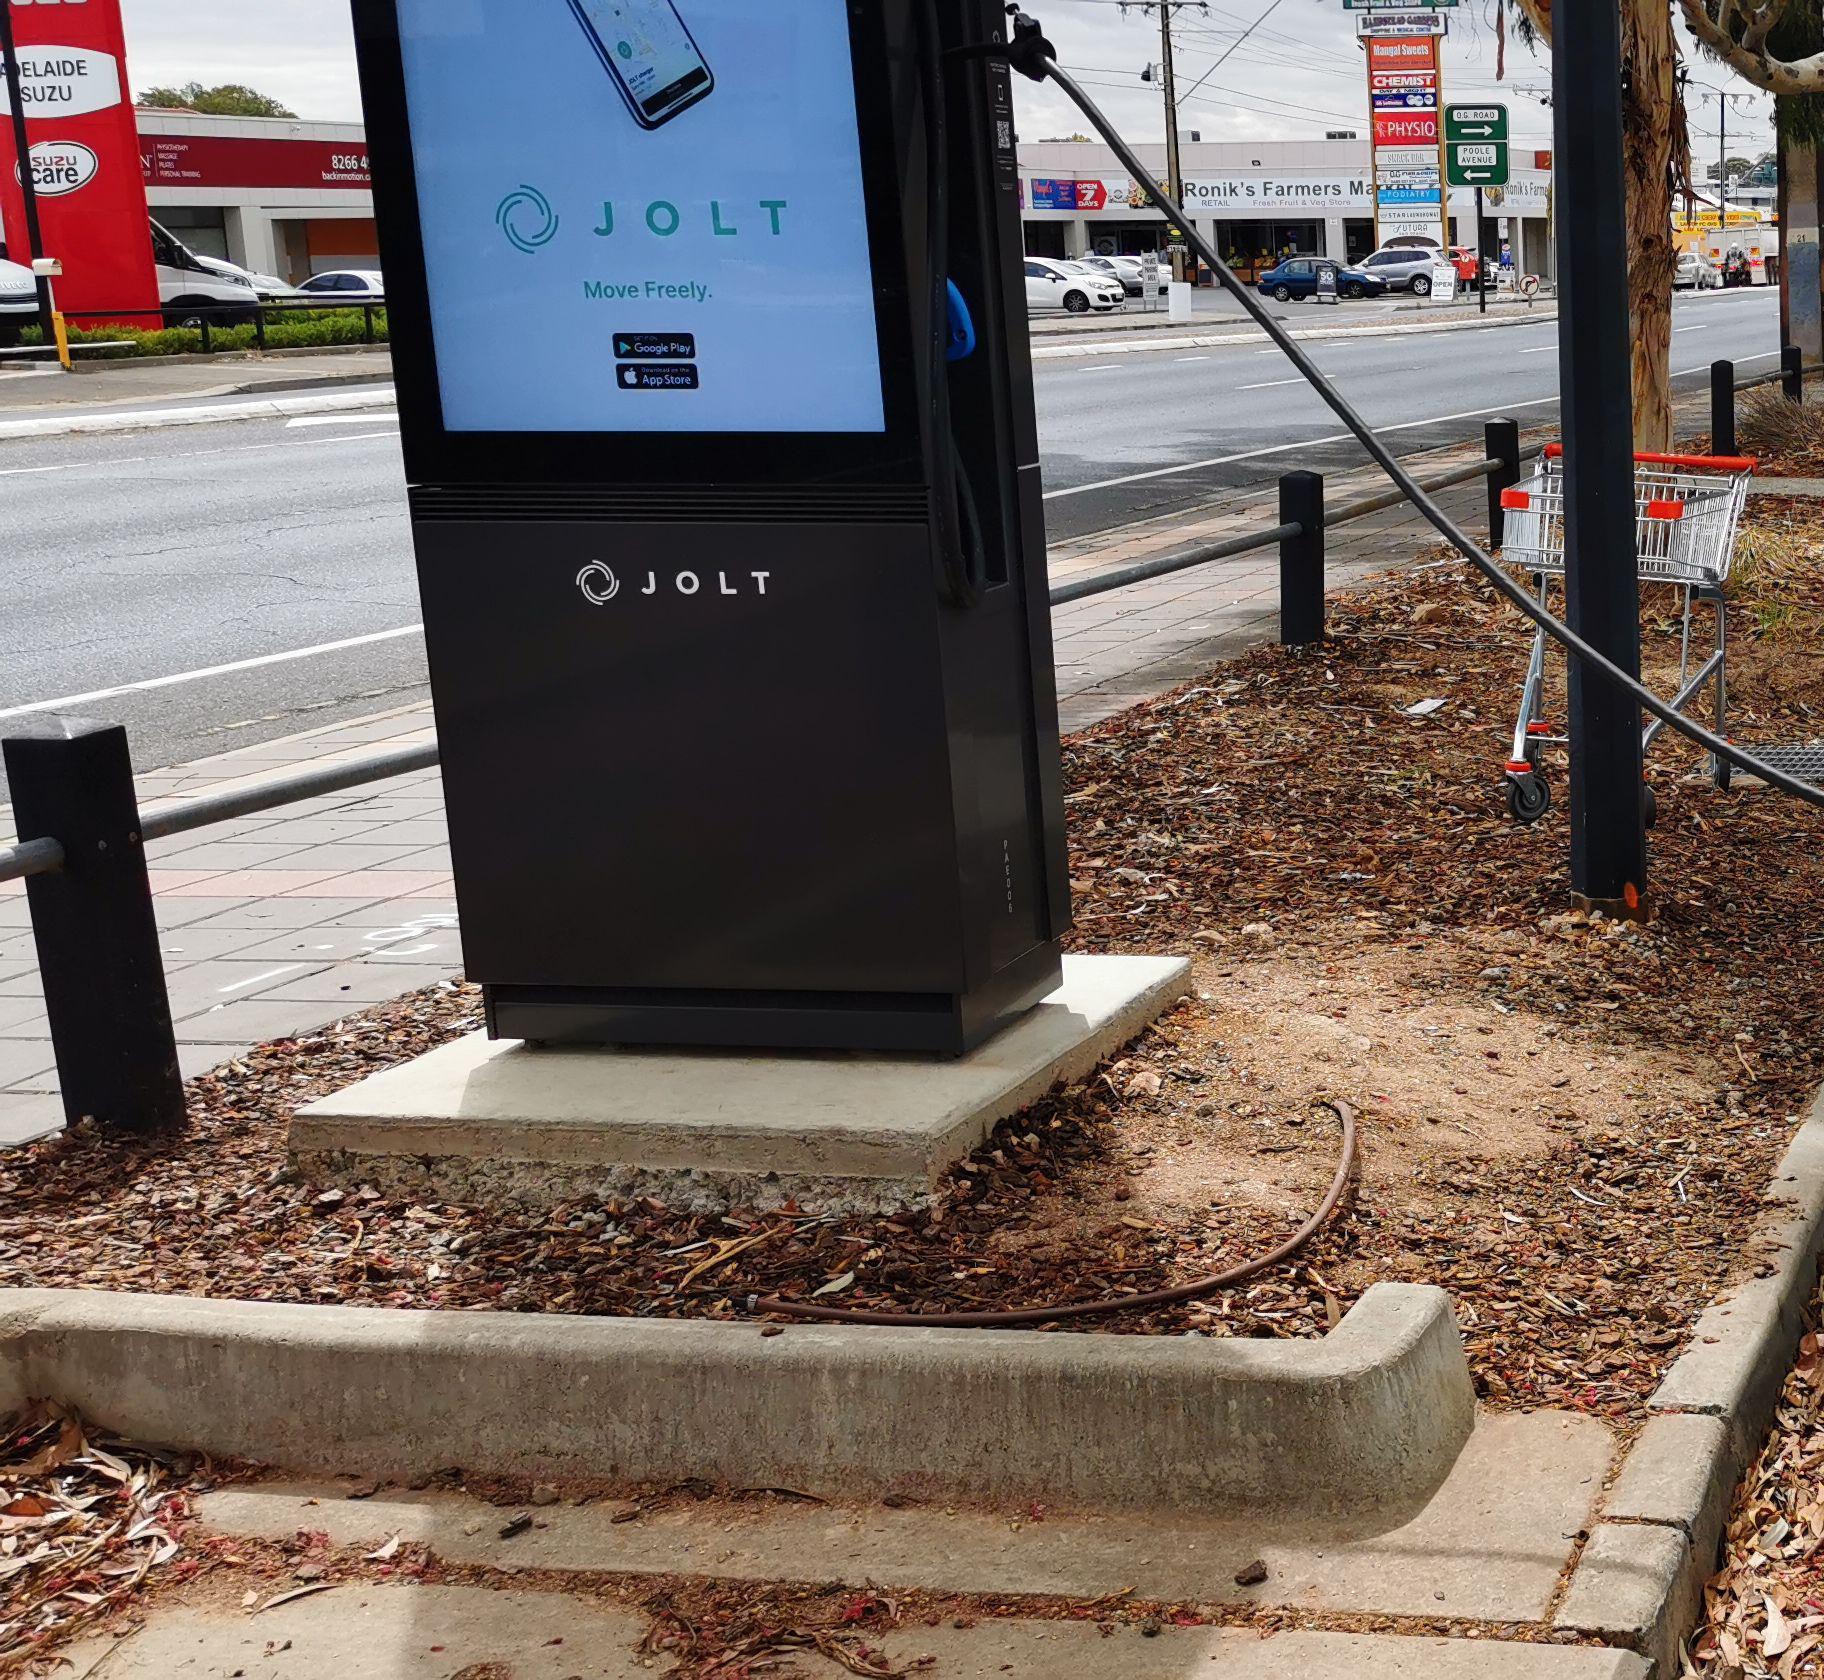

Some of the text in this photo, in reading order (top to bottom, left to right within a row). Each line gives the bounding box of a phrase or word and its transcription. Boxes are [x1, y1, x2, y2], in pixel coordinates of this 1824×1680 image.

[1373, 44, 1429, 56] Mangal Sweets
[1373, 75, 1433, 87] CHEMIST
[20, 85, 72, 103] SUZU
[1473, 111, 1495, 119] ROAD
[1387, 121, 1435, 137] PHYSIO
[1463, 147, 1490, 155] POOLE
[31, 155, 78, 168] SUZU
[331, 155, 358, 169] 8266
[1461, 156, 1493, 164] AVENUE
[1184, 181, 1256, 197] Ronik's
[1263, 181, 1342, 197] Farmers
[1387, 190, 1430, 198] PODIATRY
[1081, 190, 1095, 201] 7
[1201, 199, 1231, 207] RETAIL
[1252, 199, 1277, 207] Fresh
[1310, 199, 1326, 207] Veg
[1328, 198, 1351, 206] Store
[593, 200, 787, 236] JOLT
[583, 280, 713, 303] Move Freely.
[634, 342, 691, 354] Google Play
[642, 374, 691, 386] App Store
[641, 570, 770, 595] JOLT
